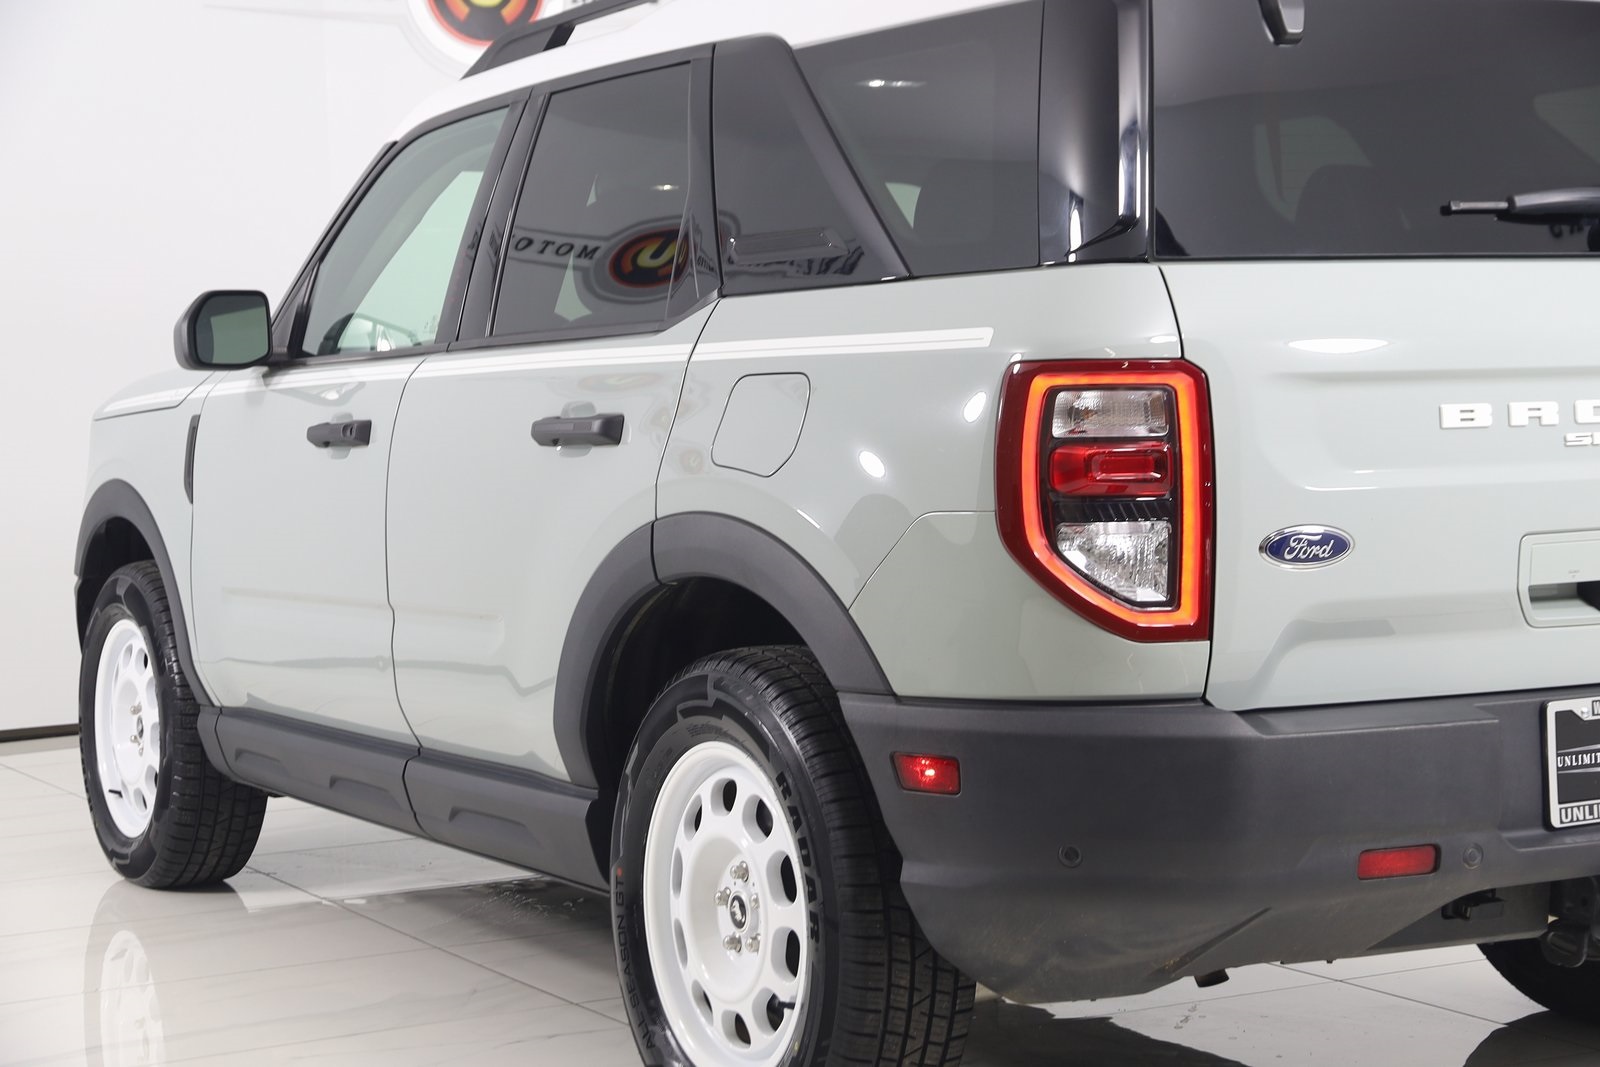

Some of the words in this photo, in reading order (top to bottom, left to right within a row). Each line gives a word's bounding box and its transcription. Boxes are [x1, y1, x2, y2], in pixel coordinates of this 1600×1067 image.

[1564, 431, 1600, 447] S
[1284, 534, 1335, 560] Ford
[1561, 804, 1600, 823] UNLI
[775, 770, 821, 944] RADAR
[615, 874, 625, 907] GT
[616, 913, 640, 1009] SEASON
